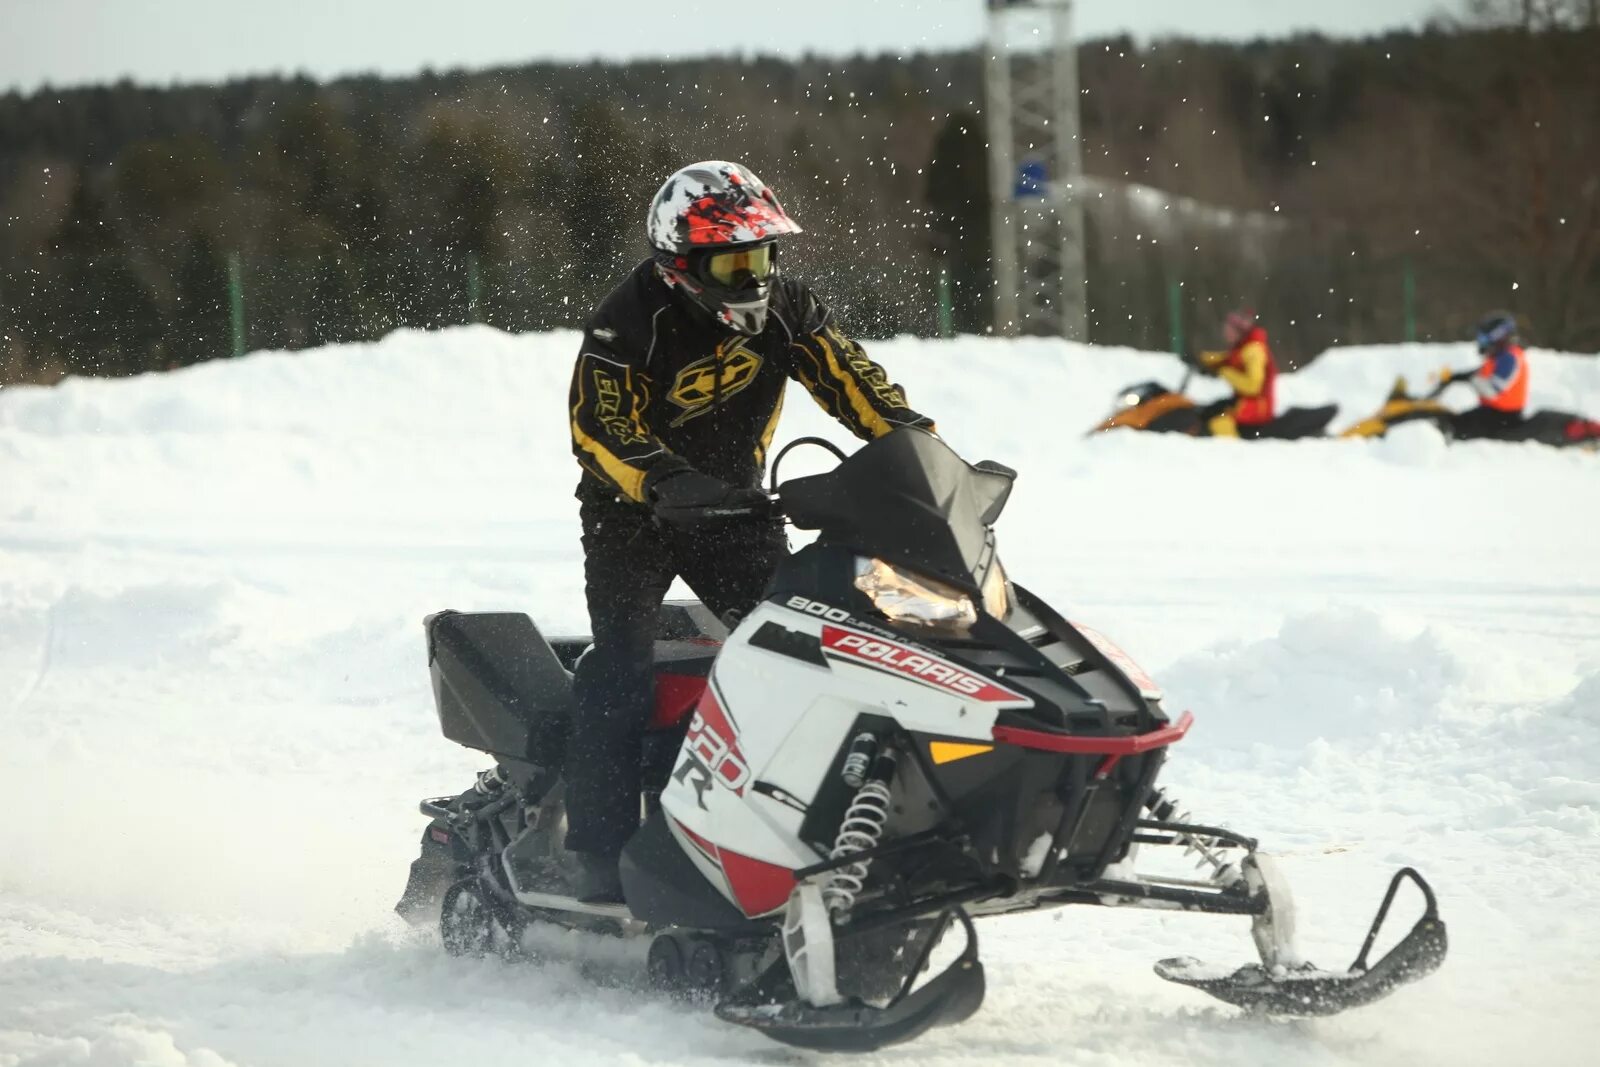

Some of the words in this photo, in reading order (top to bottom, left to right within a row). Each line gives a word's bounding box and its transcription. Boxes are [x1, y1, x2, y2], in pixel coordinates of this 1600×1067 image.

[786, 595, 850, 623] 800
[833, 634, 988, 695] POLARIS
[671, 748, 714, 812] R
